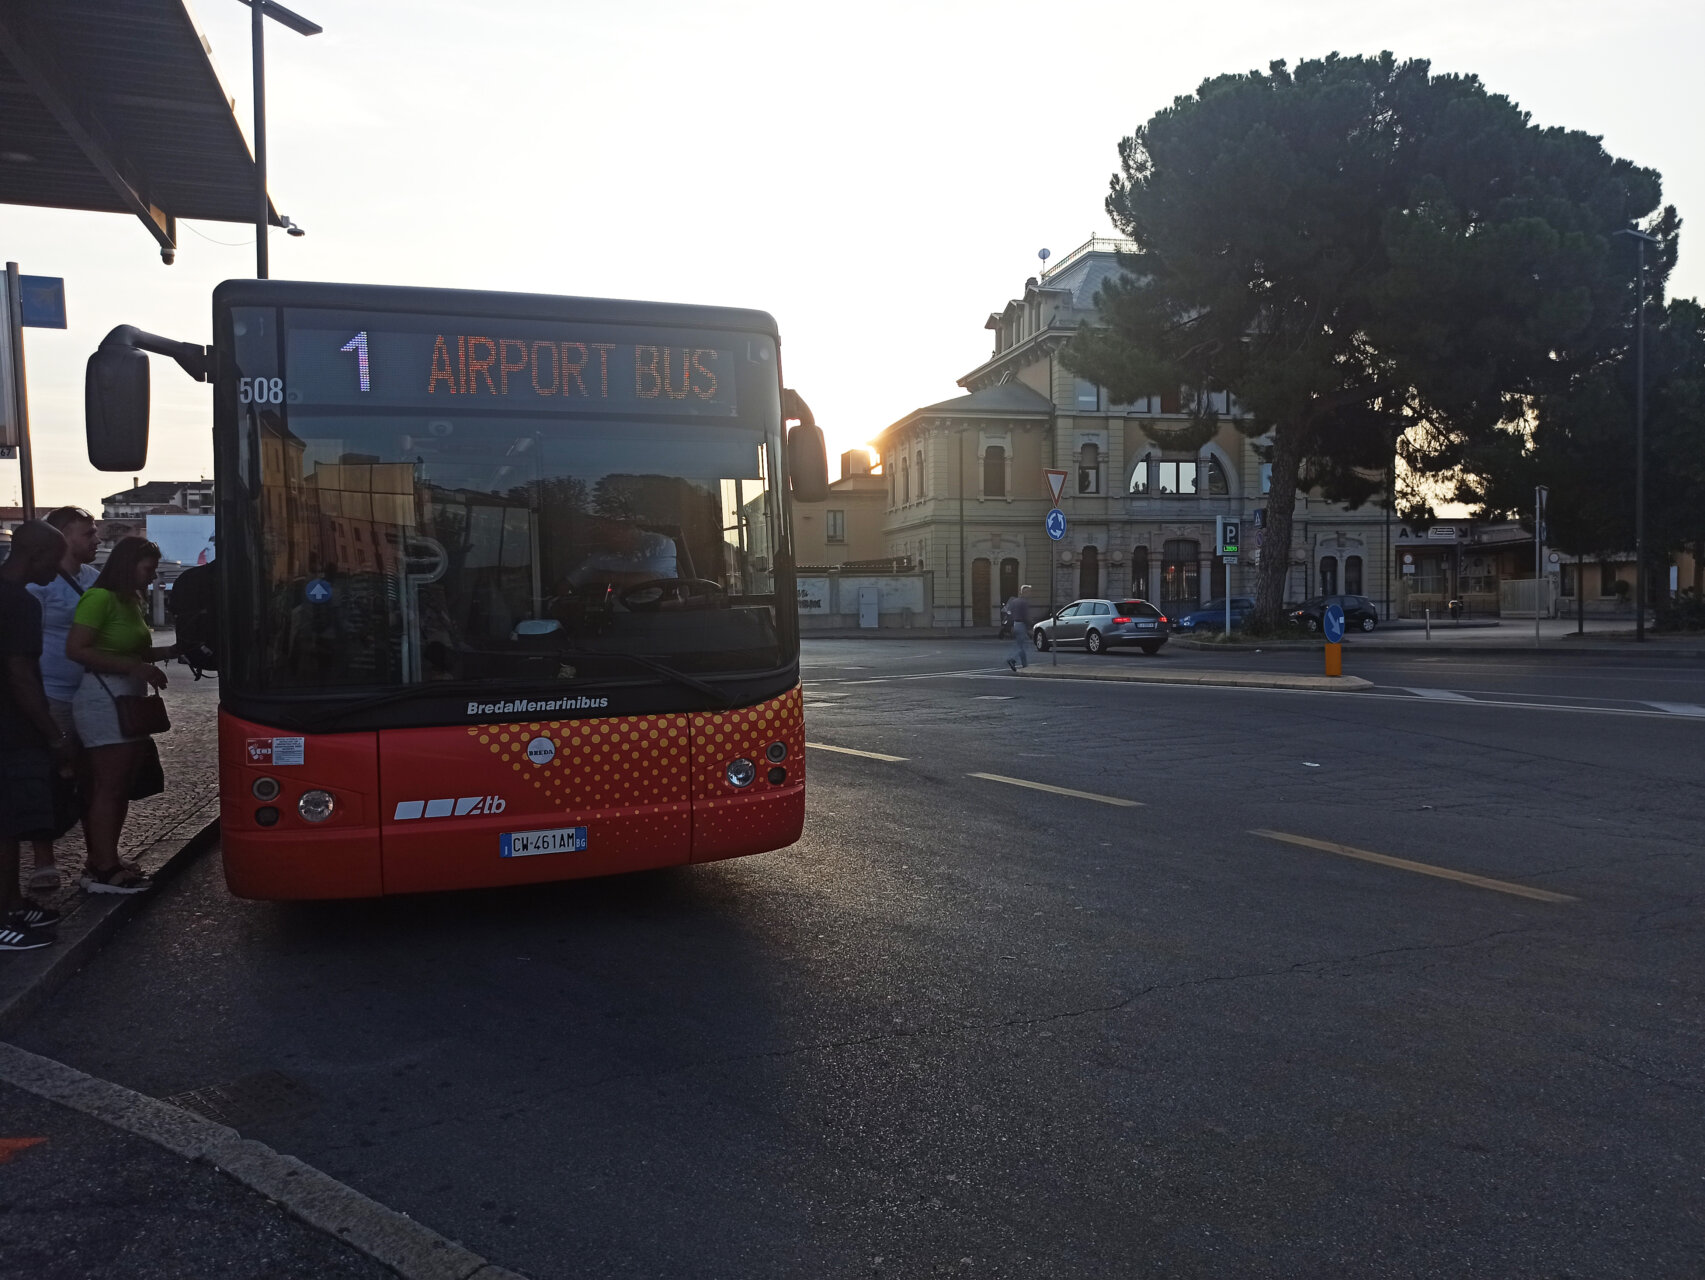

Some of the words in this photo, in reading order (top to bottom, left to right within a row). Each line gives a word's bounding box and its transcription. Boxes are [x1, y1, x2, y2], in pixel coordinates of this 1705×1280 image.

[340, 331, 370, 392] 1
[428, 334, 617, 398] AIRPORT
[635, 344, 718, 399] BUS
[239, 377, 284, 404] 508
[1225, 525, 1236, 543] P
[467, 697, 608, 714] BredaMenarinibus
